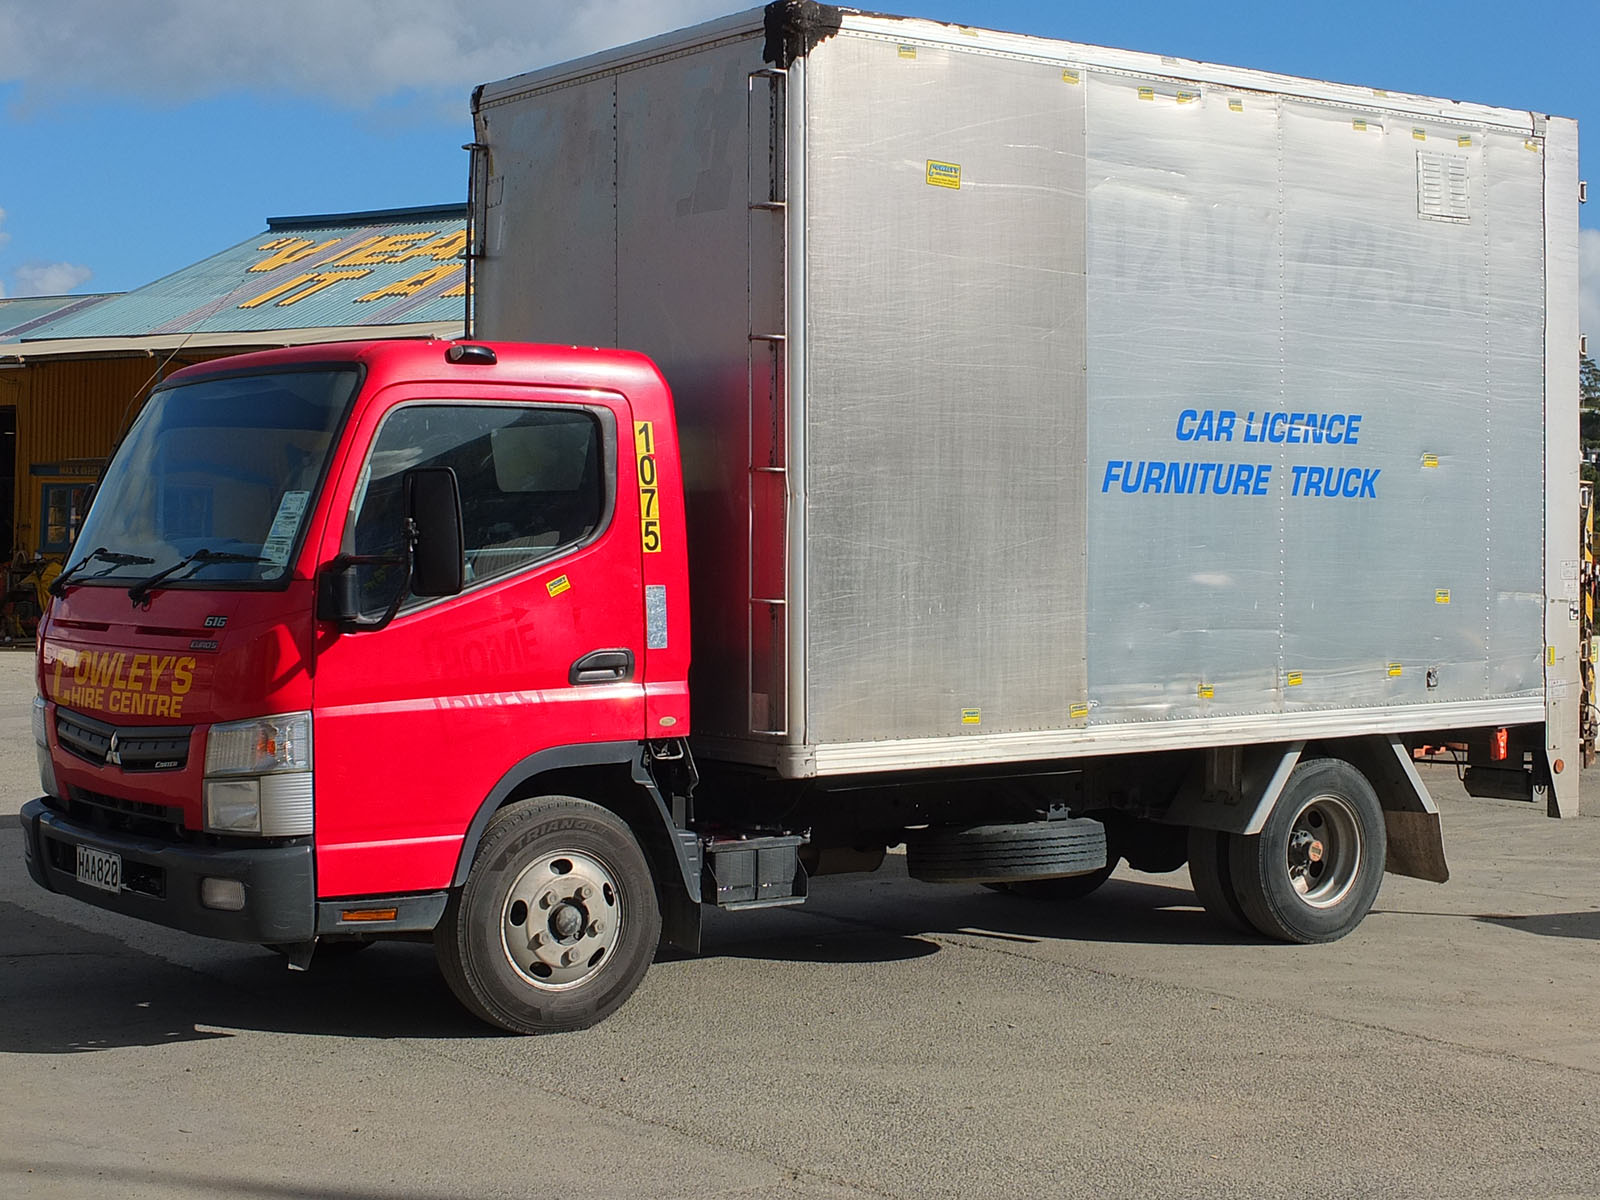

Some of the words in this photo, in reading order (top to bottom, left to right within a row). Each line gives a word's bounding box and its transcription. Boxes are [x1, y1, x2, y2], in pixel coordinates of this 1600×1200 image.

[237, 269, 374, 309] IT
[1175, 409, 1236, 441] CAR
[1243, 411, 1362, 445] LICENCE
[638, 423, 659, 551] 1075
[1102, 460, 1272, 495] FURNITURE
[1291, 466, 1381, 498] TRUCK
[203, 616, 228, 627] 616
[71, 686, 104, 710] HIRE
[109, 690, 185, 719] CENTRE
[78, 851, 118, 887] HAA820
